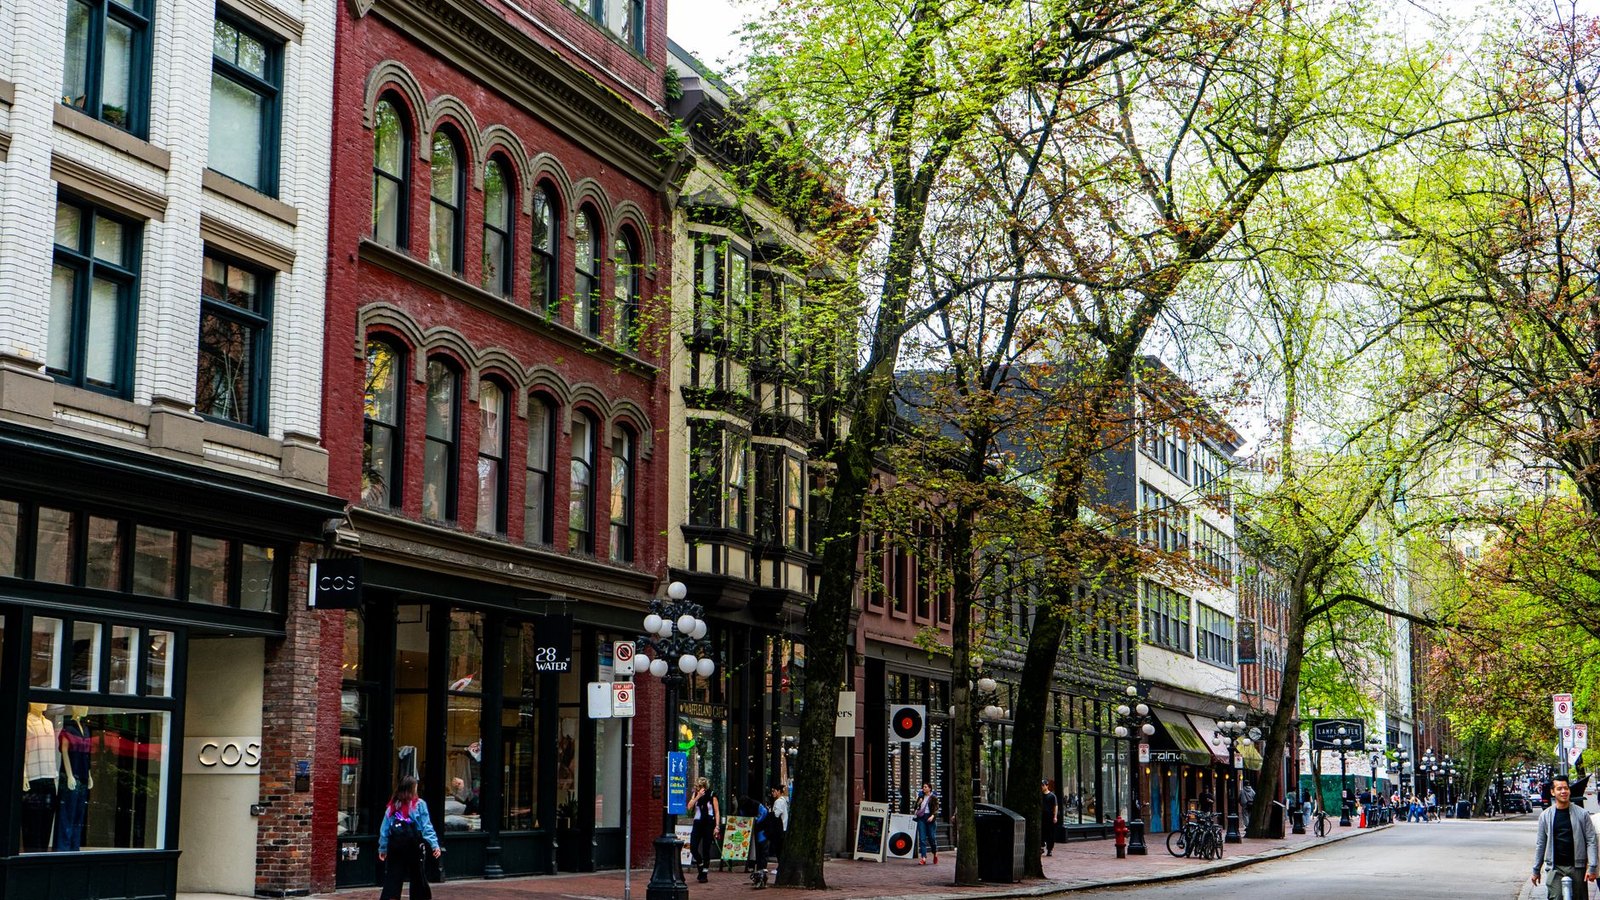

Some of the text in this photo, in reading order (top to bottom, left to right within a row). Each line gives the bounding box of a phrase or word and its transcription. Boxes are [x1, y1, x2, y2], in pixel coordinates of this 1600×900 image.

[320, 576, 356, 591] COS
[535, 647, 557, 662] 28
[535, 662, 568, 671] WATER
[837, 710, 853, 718] ers
[199, 743, 261, 768] COS
